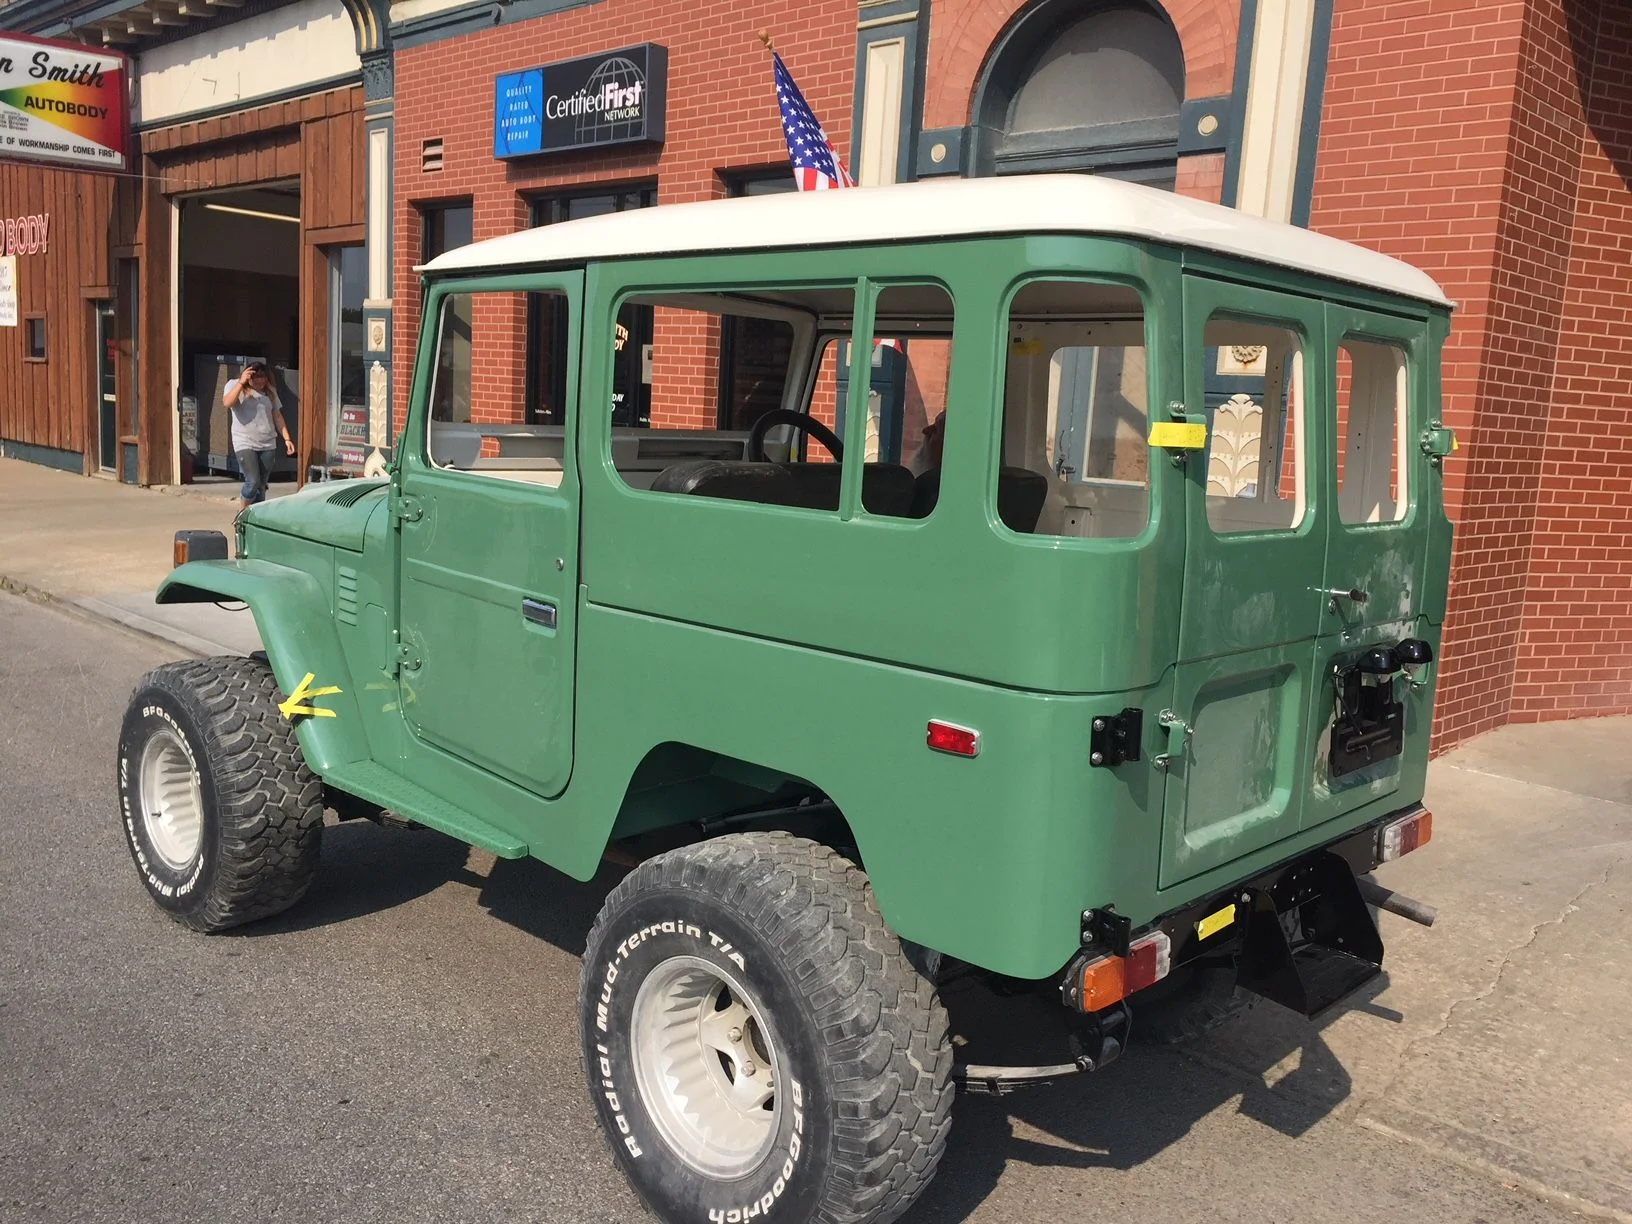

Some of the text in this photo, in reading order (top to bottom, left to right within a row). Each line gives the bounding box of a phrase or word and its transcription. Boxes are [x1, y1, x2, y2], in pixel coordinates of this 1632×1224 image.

[28, 51, 104, 88] Smith
[506, 85, 532, 98] QUALITY
[24, 95, 108, 119] AUTOBODY
[509, 101, 529, 112] RATED
[604, 106, 640, 121] NETWORK
[501, 114, 536, 128] AUTO BODY
[507, 130, 529, 142] REPAIR
[18, 138, 69, 152] WORKMANSHIP
[72, 145, 95, 156] COMES
[98, 149, 115, 159] FIRST
[596, 919, 747, 1159] Radial Mud-Terrain T/A
[708, 1078, 804, 1224] BFGoodrich
